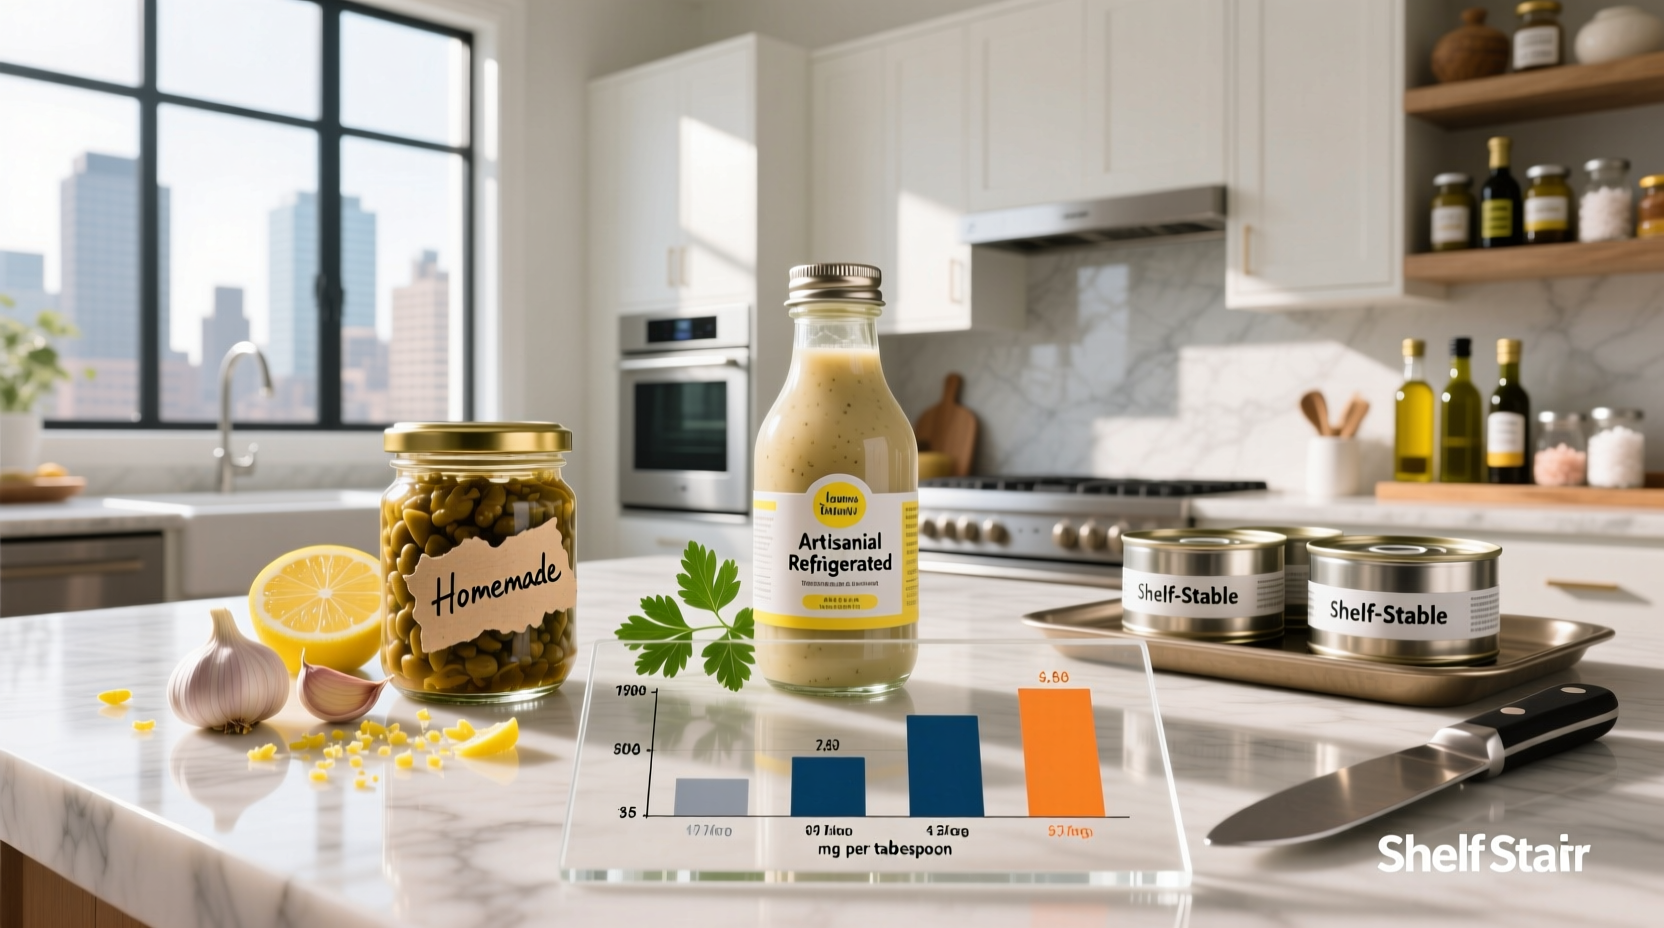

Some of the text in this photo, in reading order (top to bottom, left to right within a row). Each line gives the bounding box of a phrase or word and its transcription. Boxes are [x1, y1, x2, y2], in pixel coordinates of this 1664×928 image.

[798, 531, 882, 551] Artisanial
[788, 553, 893, 578] Refrigerated
[431, 551, 562, 617] Homemade
[1137, 583, 1239, 605] Shelf-Stable
[1329, 599, 1449, 625] Shelf-Stable
[818, 840, 952, 859] mg per tabespoon
